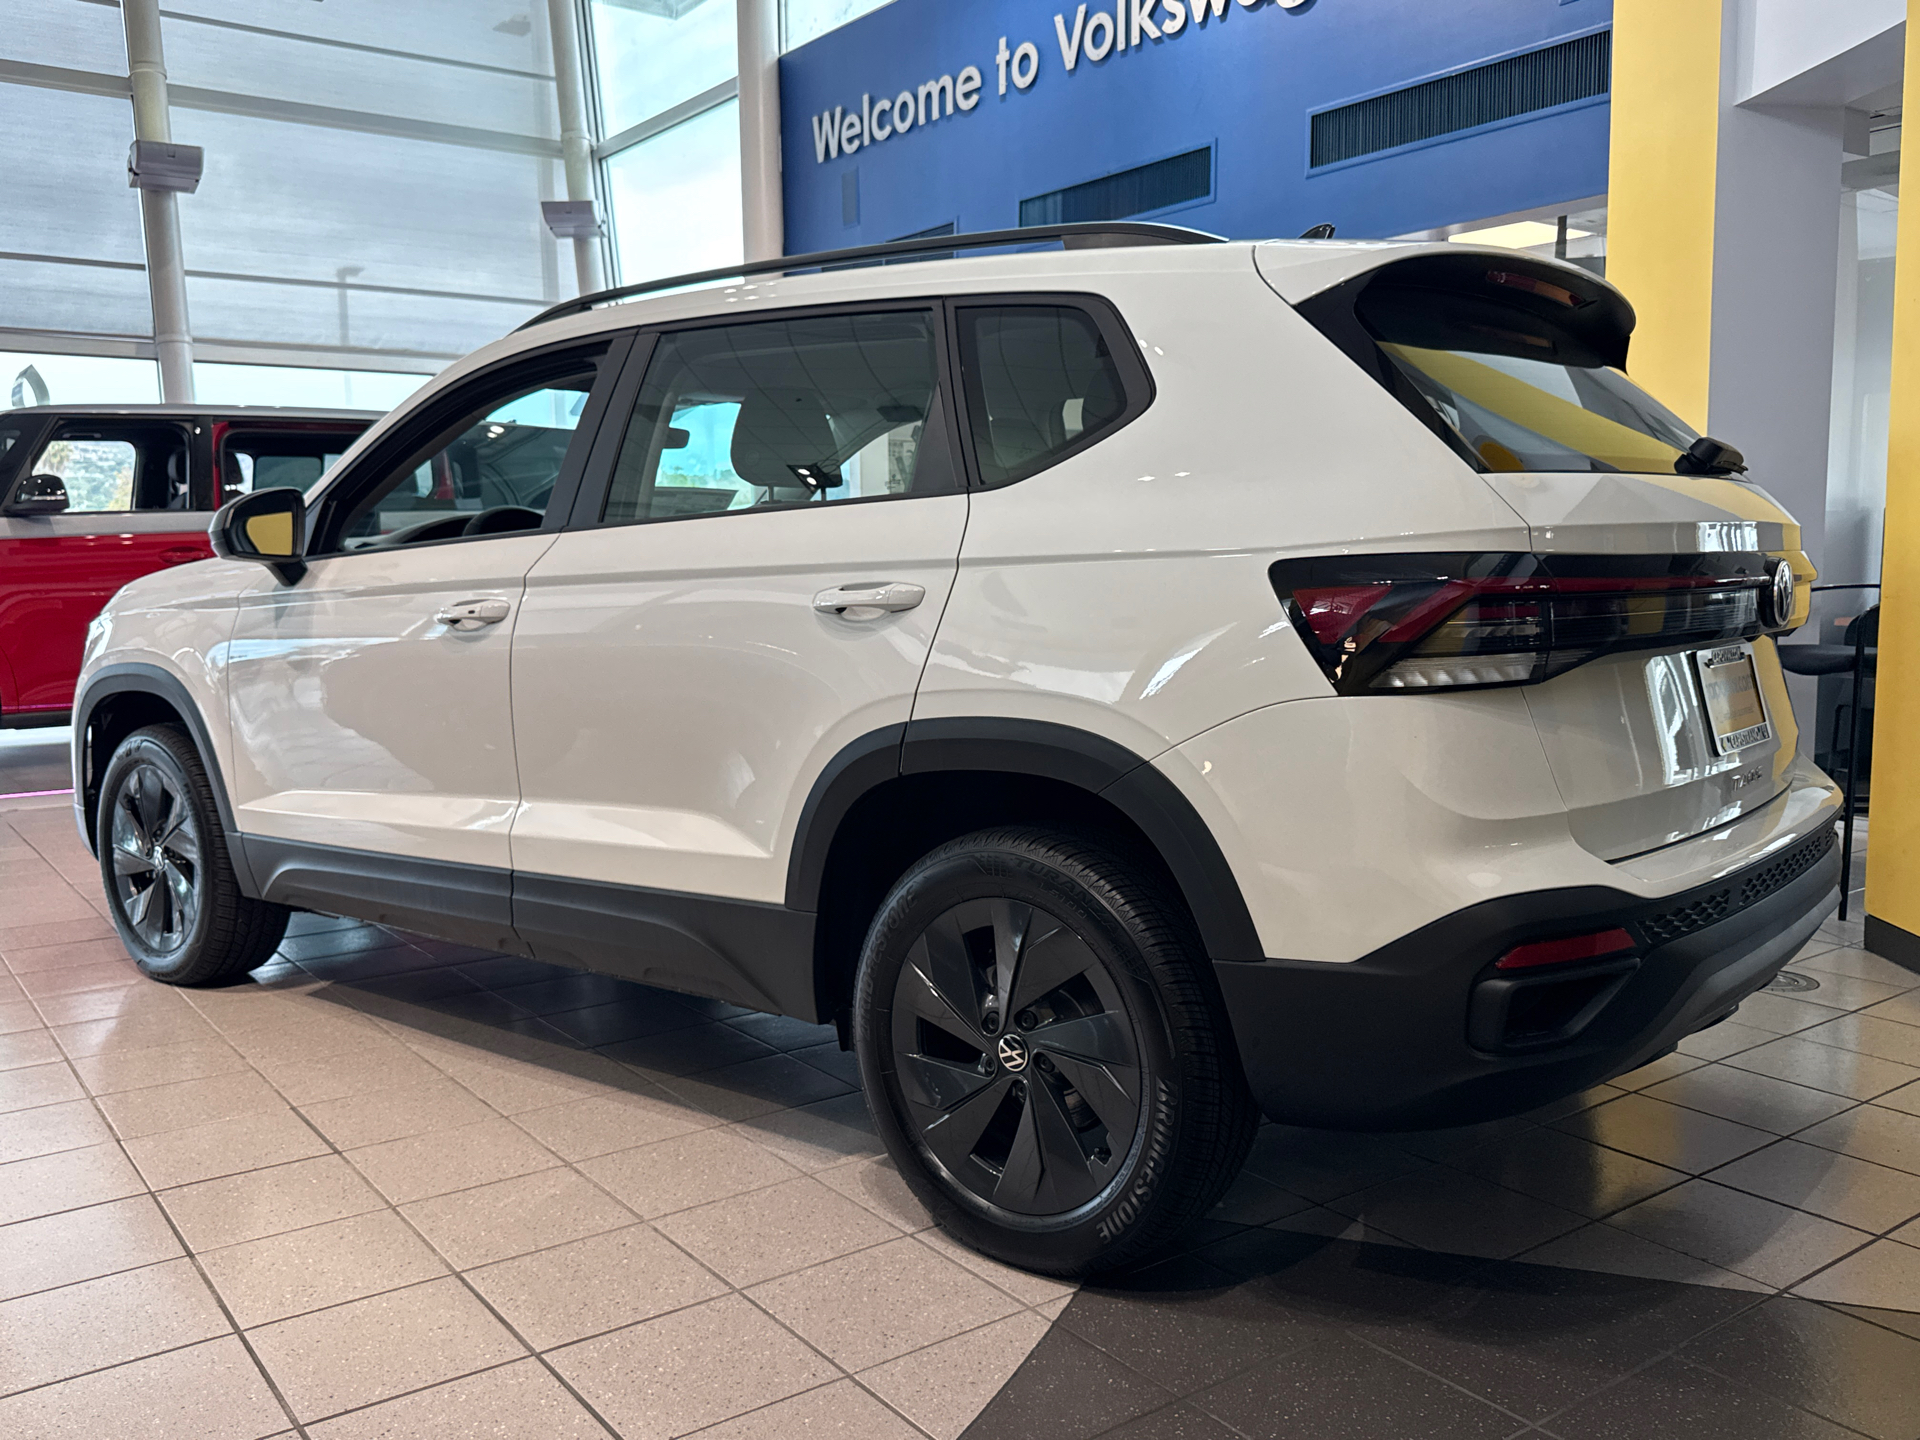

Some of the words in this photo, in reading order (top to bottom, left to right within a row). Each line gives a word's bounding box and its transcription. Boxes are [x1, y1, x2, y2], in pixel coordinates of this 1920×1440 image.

[811, 65, 982, 164] Welcome
[995, 36, 1039, 96] to
[1012, 857, 1121, 939] TURANZA
[1095, 1074, 1180, 1246] BRIDGESTONE
